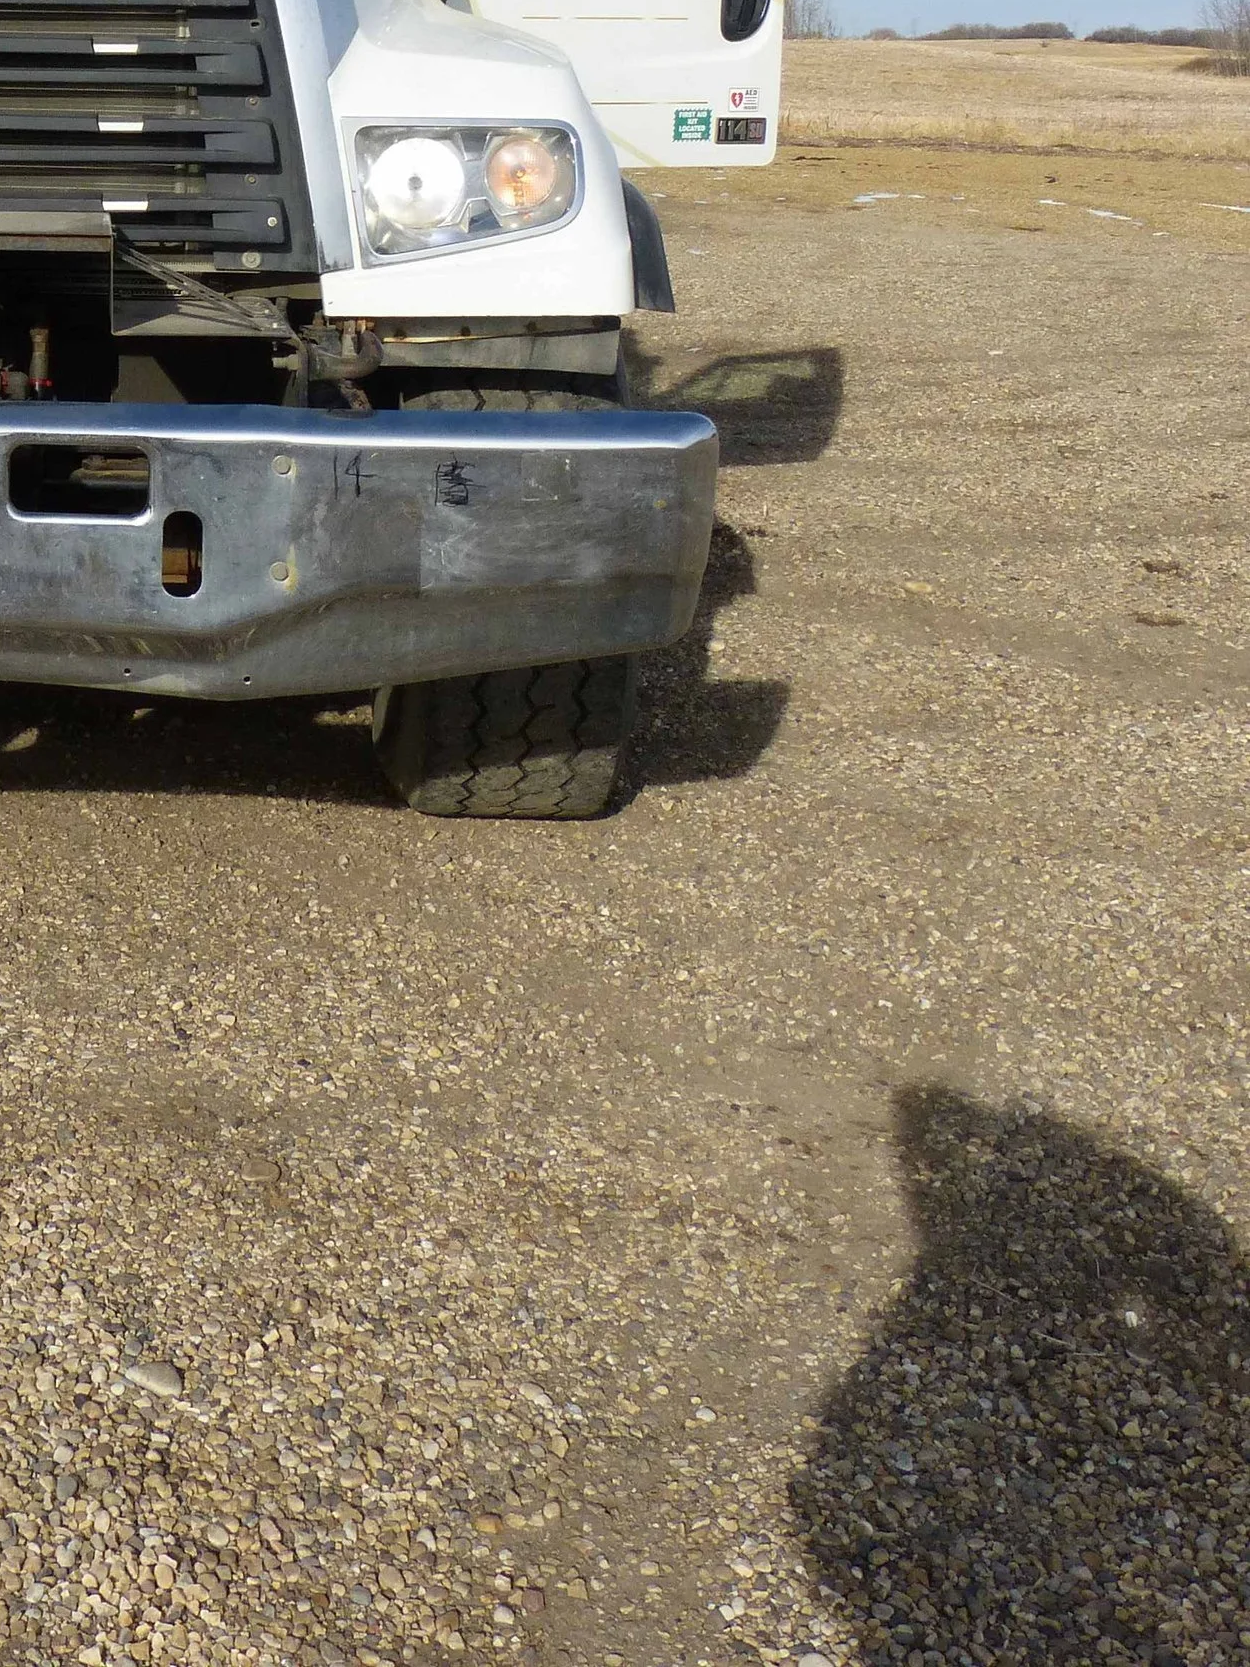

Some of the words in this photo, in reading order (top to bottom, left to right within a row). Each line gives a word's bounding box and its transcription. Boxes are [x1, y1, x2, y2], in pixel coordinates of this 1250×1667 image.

[678, 124, 706, 132] LOCATED
[719, 120, 747, 140] 114
[333, 450, 381, 500] 14
